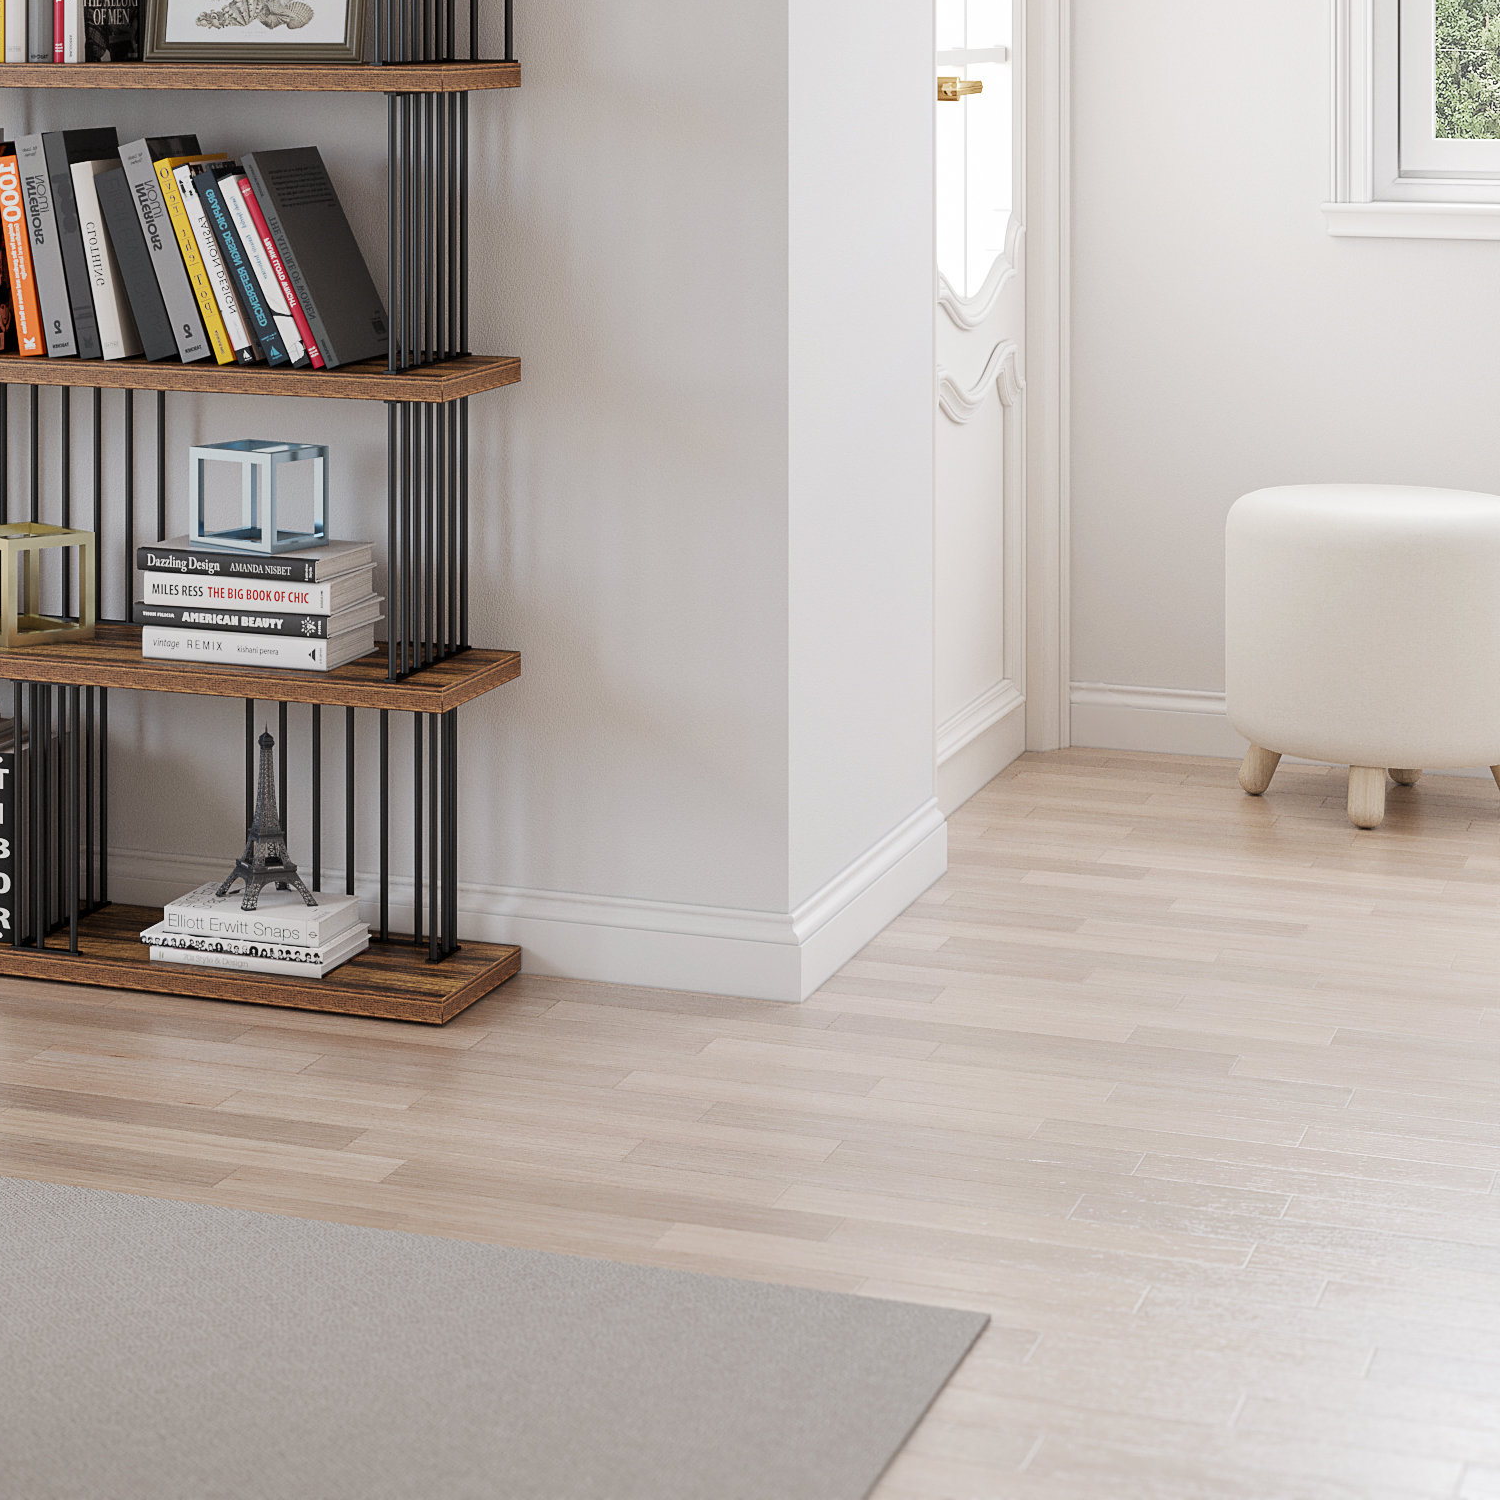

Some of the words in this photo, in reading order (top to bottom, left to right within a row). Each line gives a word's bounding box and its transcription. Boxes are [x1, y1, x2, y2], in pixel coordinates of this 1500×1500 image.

[93, 8, 106, 26] OF
[108, 8, 130, 25] MEN
[146, 554, 187, 572] Dazzling
[188, 557, 220, 574] Design
[230, 563, 264, 574] AMANDA
[265, 565, 292, 576] NISBET
[151, 583, 179, 596] MILES
[182, 585, 204, 597] RESS
[208, 586, 225, 599] THE
[227, 588, 244, 600] BIG
[246, 589, 272, 602] BOOK
[274, 591, 286, 602] OF
[288, 591, 309, 604] CHIC
[181, 611, 239, 626] AMERICAN
[240, 615, 284, 629] BEAUTY
[152, 638, 180, 650] vintage
[186, 639, 223, 651] REMIX
[168, 912, 204, 931] Elliott
[209, 917, 249, 935] Erwitt
[253, 922, 300, 941] Snaps
